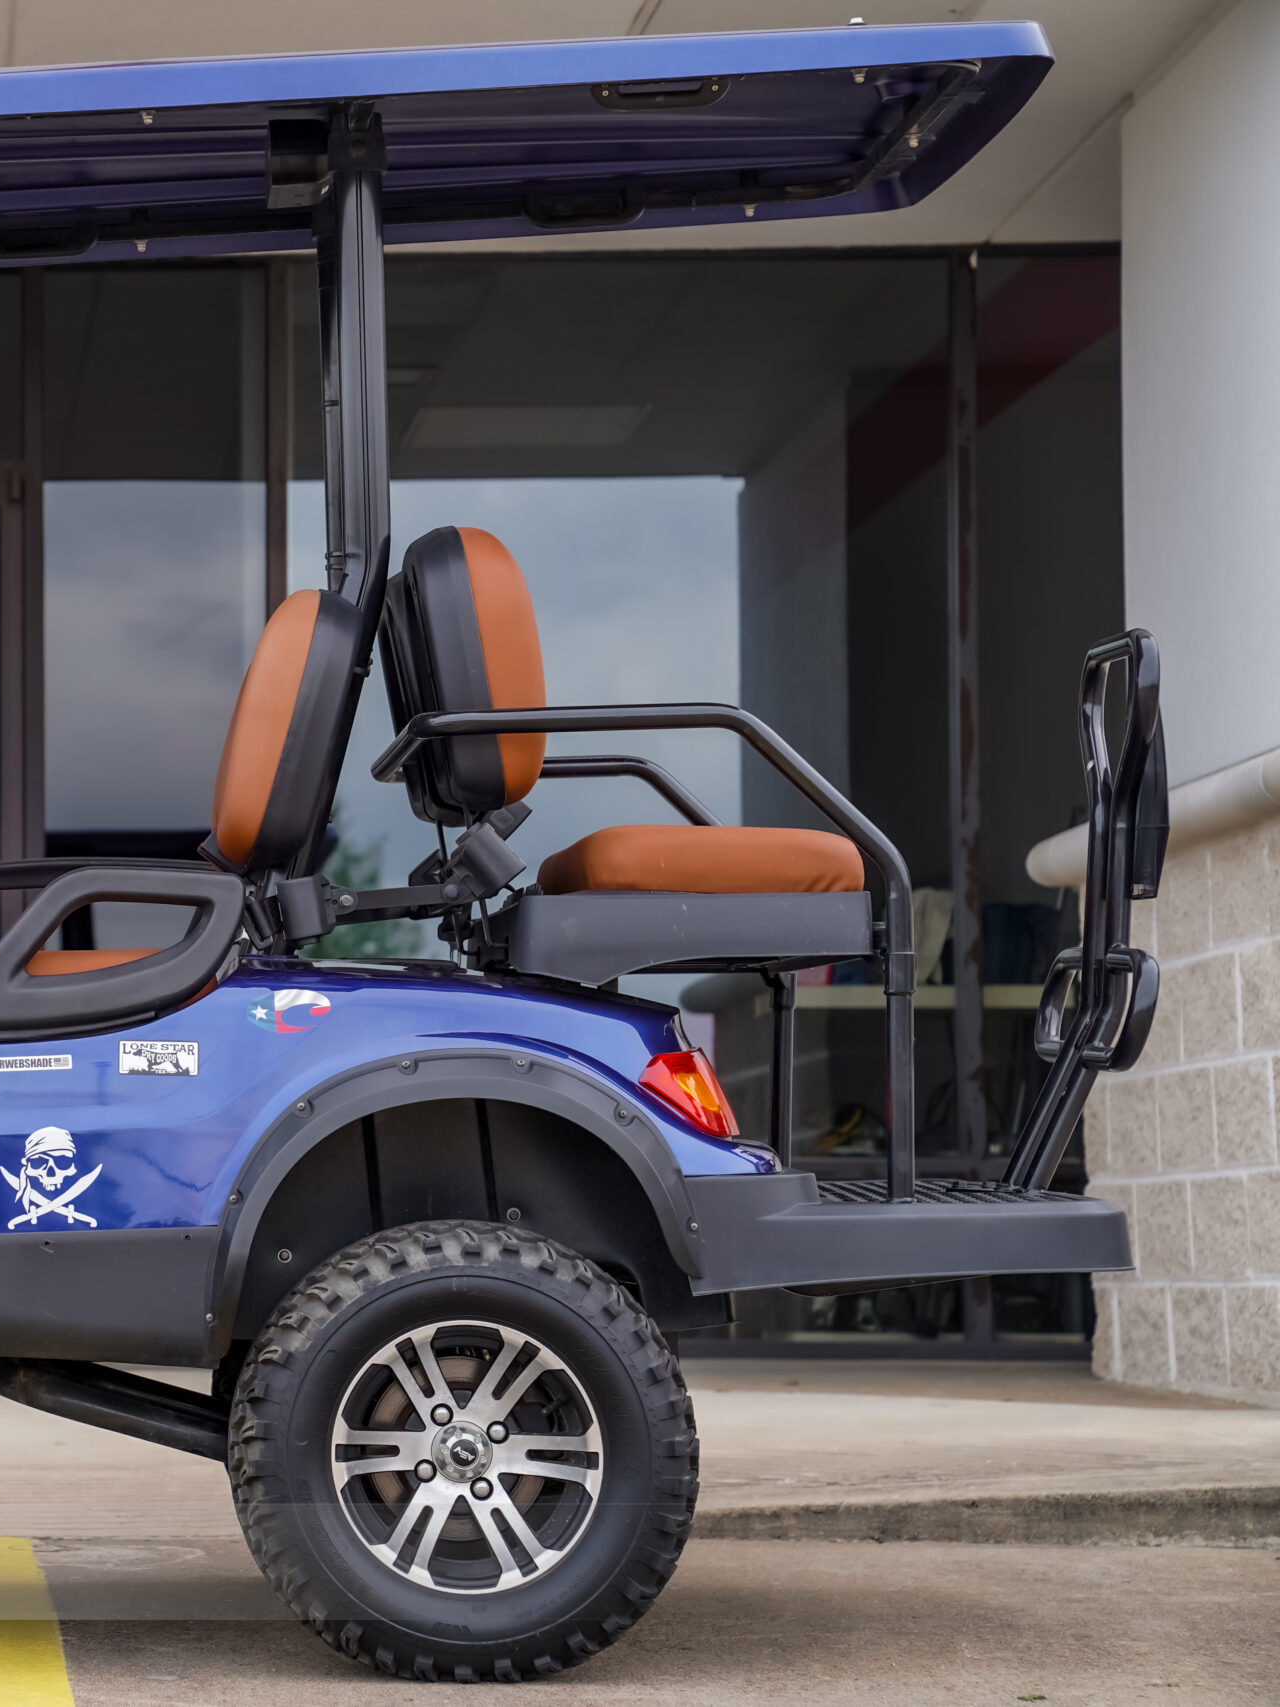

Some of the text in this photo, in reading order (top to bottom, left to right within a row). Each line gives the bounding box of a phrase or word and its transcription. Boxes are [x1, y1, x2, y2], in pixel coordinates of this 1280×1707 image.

[122, 1042, 196, 1056] LONE STAR
[156, 1053, 177, 1064] GOODS
